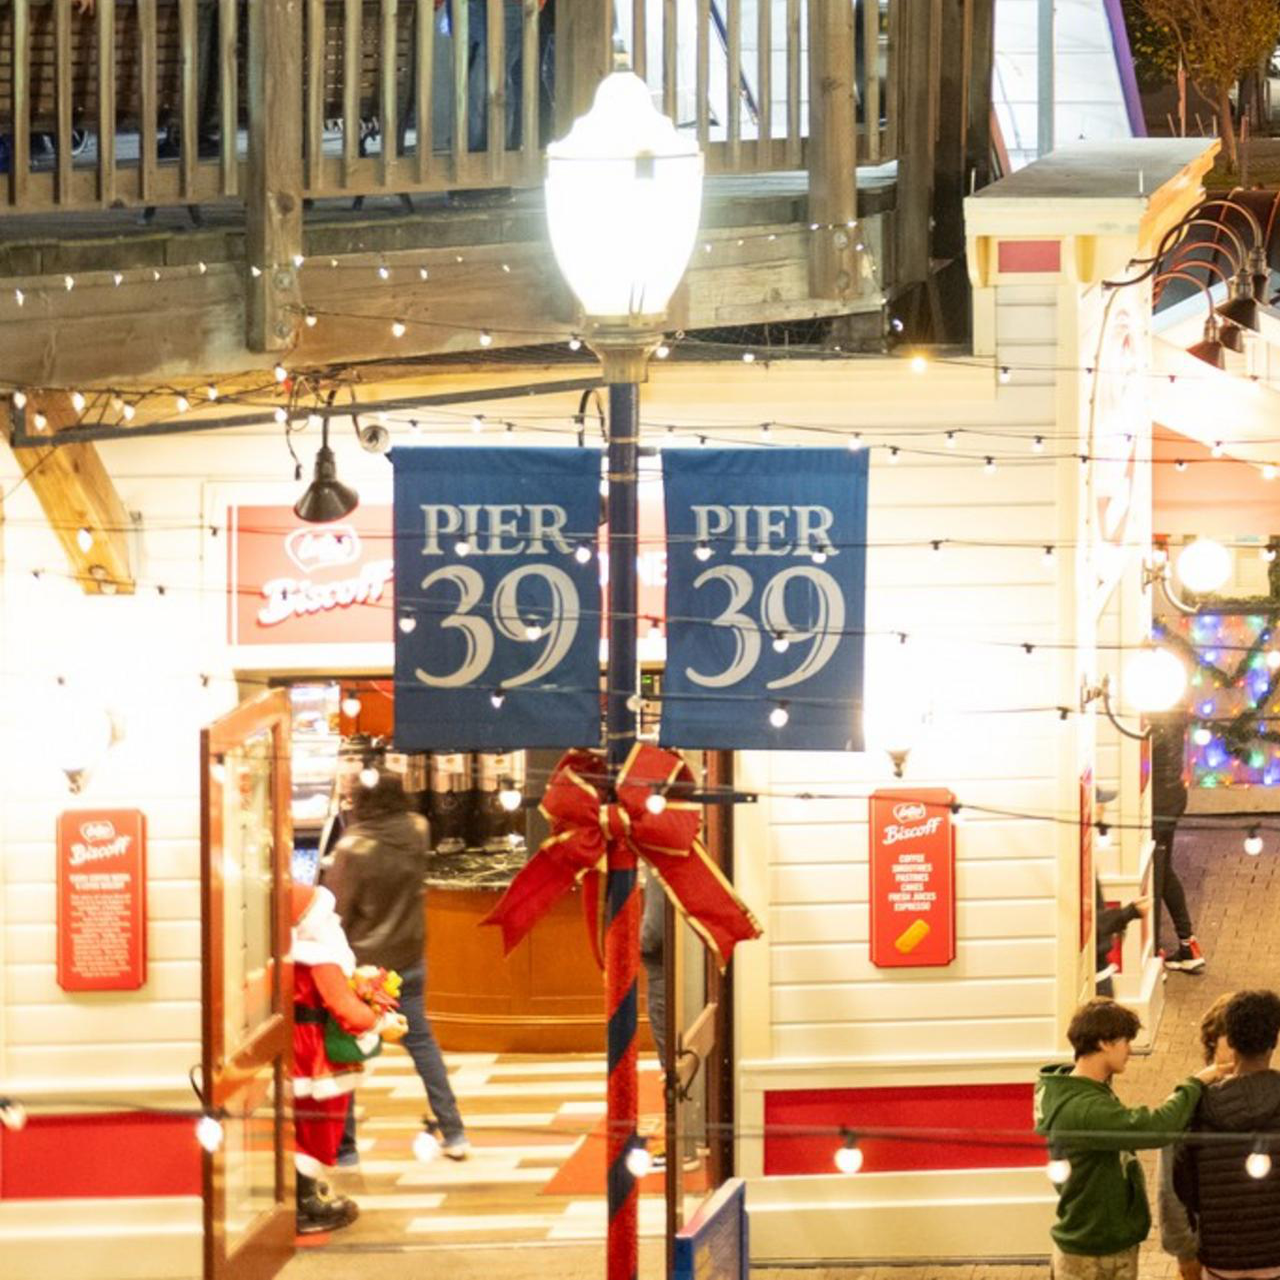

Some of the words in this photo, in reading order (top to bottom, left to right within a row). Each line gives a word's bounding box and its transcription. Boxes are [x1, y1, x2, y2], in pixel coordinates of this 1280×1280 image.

[419, 503, 578, 556] PIER
[690, 504, 841, 557] PIER
[414, 564, 580, 689] 39
[685, 565, 846, 690] 39
[69, 835, 132, 866] Biscoff
[882, 816, 944, 845] Biscoff
